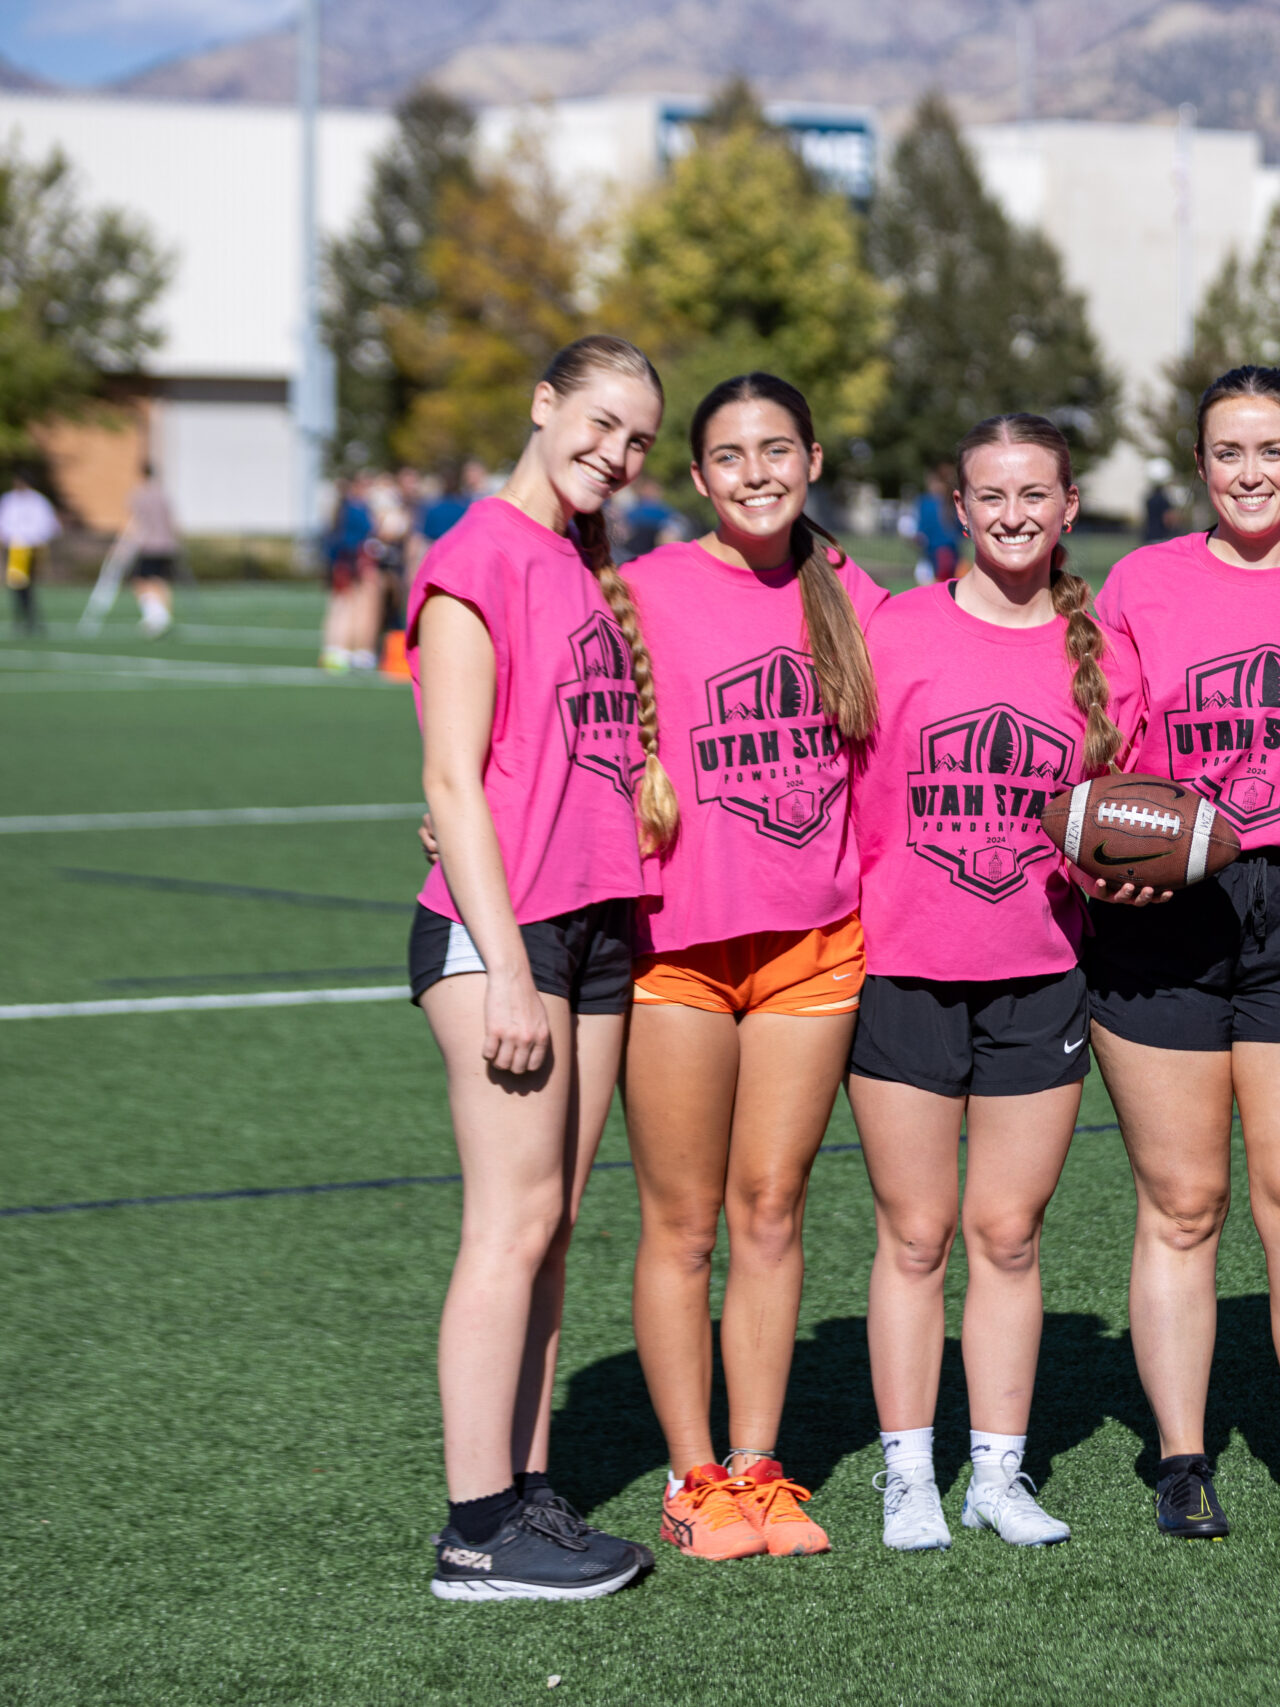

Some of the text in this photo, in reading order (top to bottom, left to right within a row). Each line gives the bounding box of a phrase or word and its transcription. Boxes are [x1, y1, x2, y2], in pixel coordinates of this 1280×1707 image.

[1173, 719, 1254, 755] UTAH
[696, 724, 845, 772] UTAH STA
[724, 764, 801, 784] POWDER
[1246, 766, 1267, 775] 2024
[786, 779, 804, 788] 2024
[911, 784, 1057, 819] UTAH STA
[923, 821, 1042, 834] POWDER PUF
[986, 836, 1006, 844] 2024
